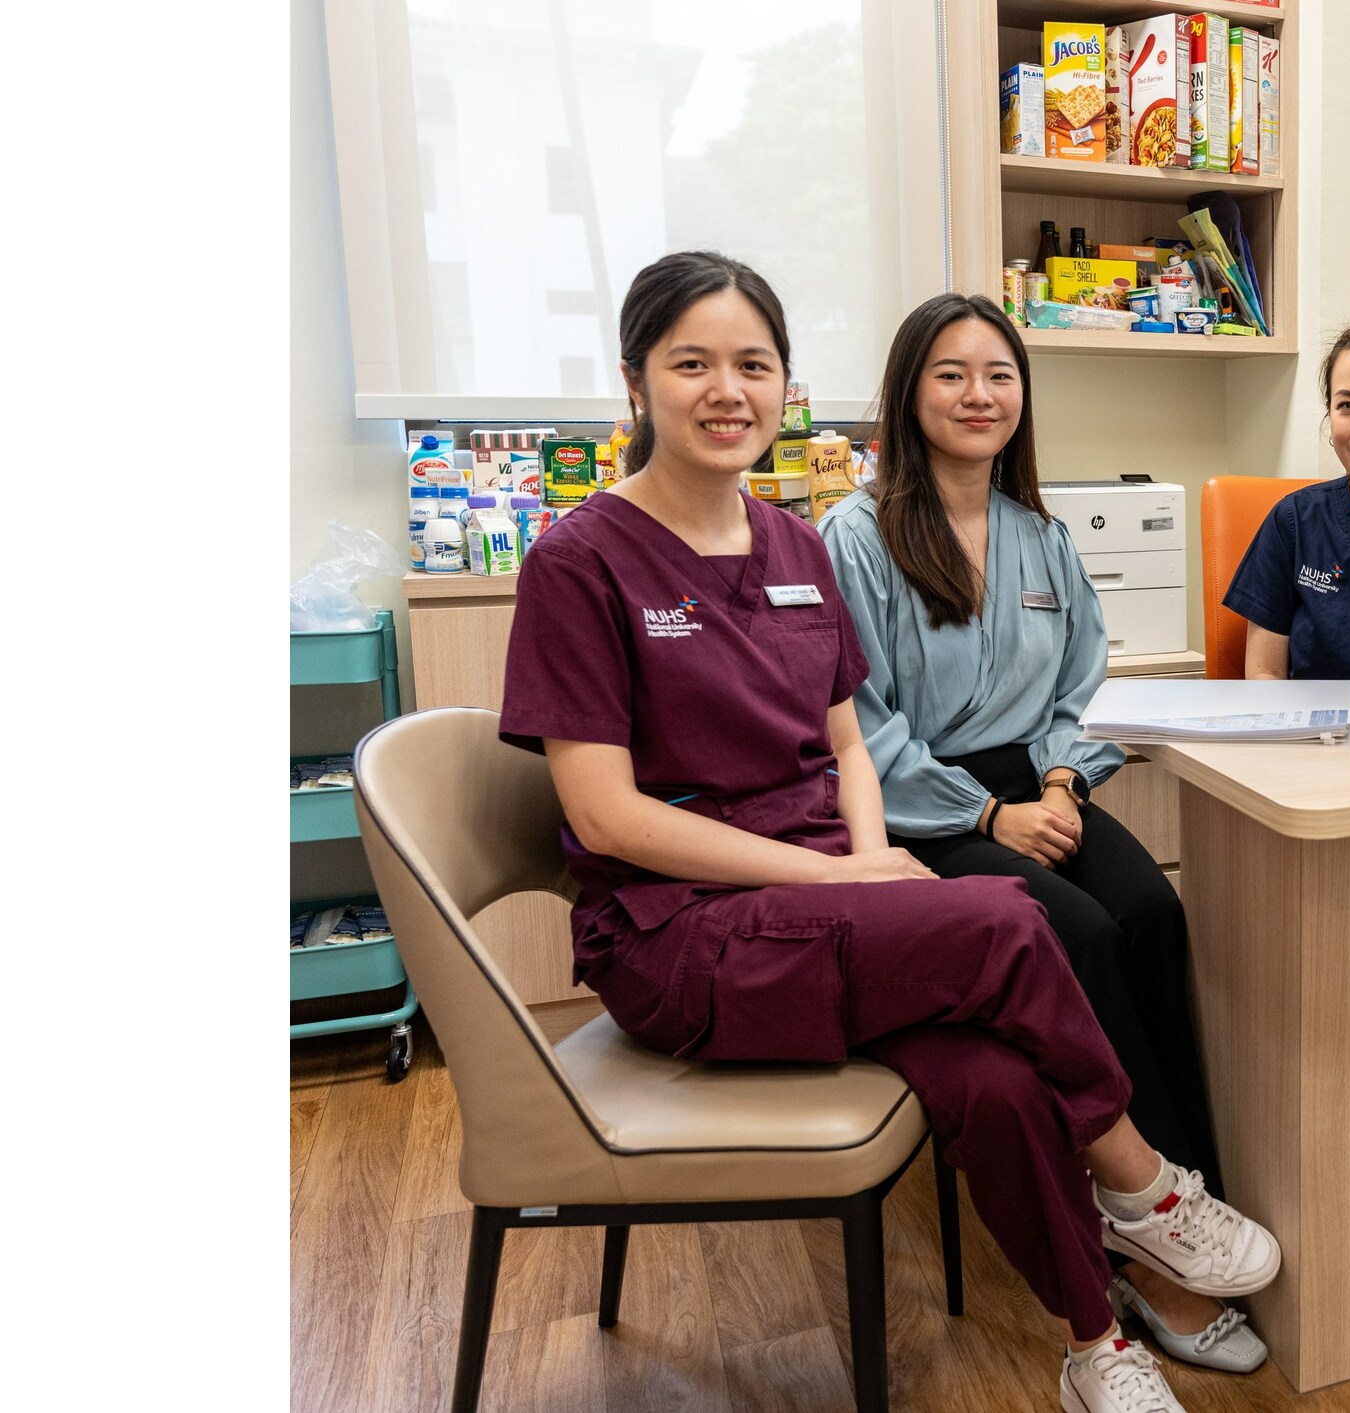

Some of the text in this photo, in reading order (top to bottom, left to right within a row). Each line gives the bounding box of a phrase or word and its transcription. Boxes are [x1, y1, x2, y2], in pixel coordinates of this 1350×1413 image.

[1049, 37, 1101, 66] JACOB'S
[1262, 49, 1278, 74] K
[1023, 70, 1044, 79] PLAIN
[1072, 71, 1101, 80] Hi-Fibre
[1137, 74, 1163, 85] Red Berries
[1073, 260, 1091, 271] TACO
[1076, 272, 1098, 283] SHELL
[782, 448, 804, 459] Naturel
[1091, 515, 1105, 530] hp
[492, 532, 513, 552] HL
[1300, 564, 1333, 584] NUHS
[1316, 582, 1340, 593] University
[643, 608, 687, 623] NUHS
[1176, 1239, 1197, 1252] adidas
